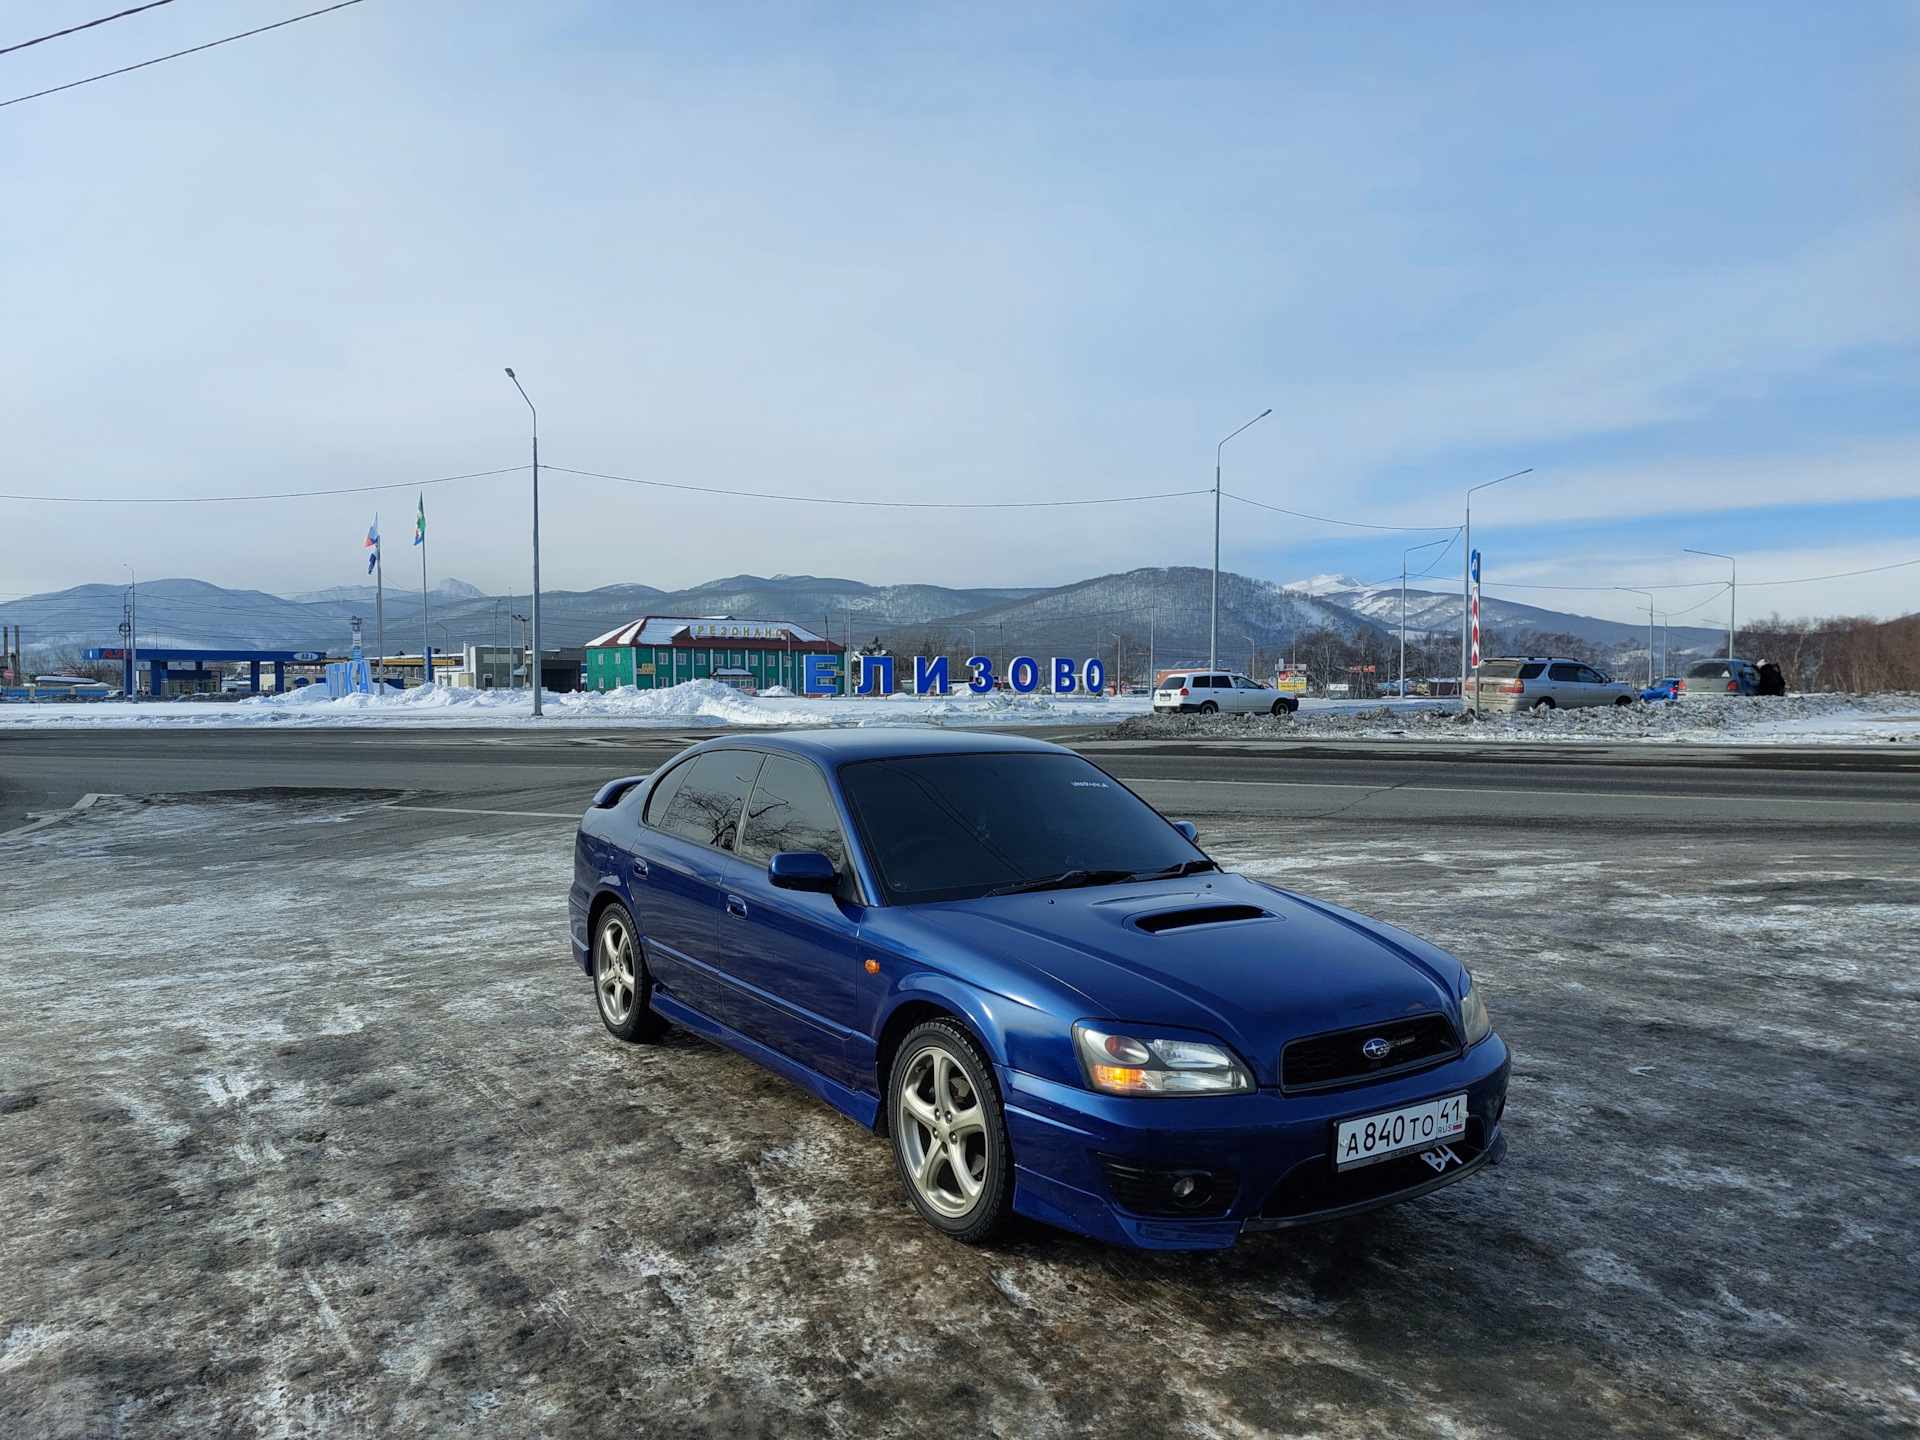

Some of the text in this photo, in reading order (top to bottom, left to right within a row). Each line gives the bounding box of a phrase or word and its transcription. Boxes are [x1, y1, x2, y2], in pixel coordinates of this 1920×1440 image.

[697, 625, 783, 637] РЕЗОНАНС
[803, 653, 1106, 695] ЕЛИЗОВО
[1440, 1099, 1460, 1124] 41
[1437, 1124, 1453, 1135] RUS
